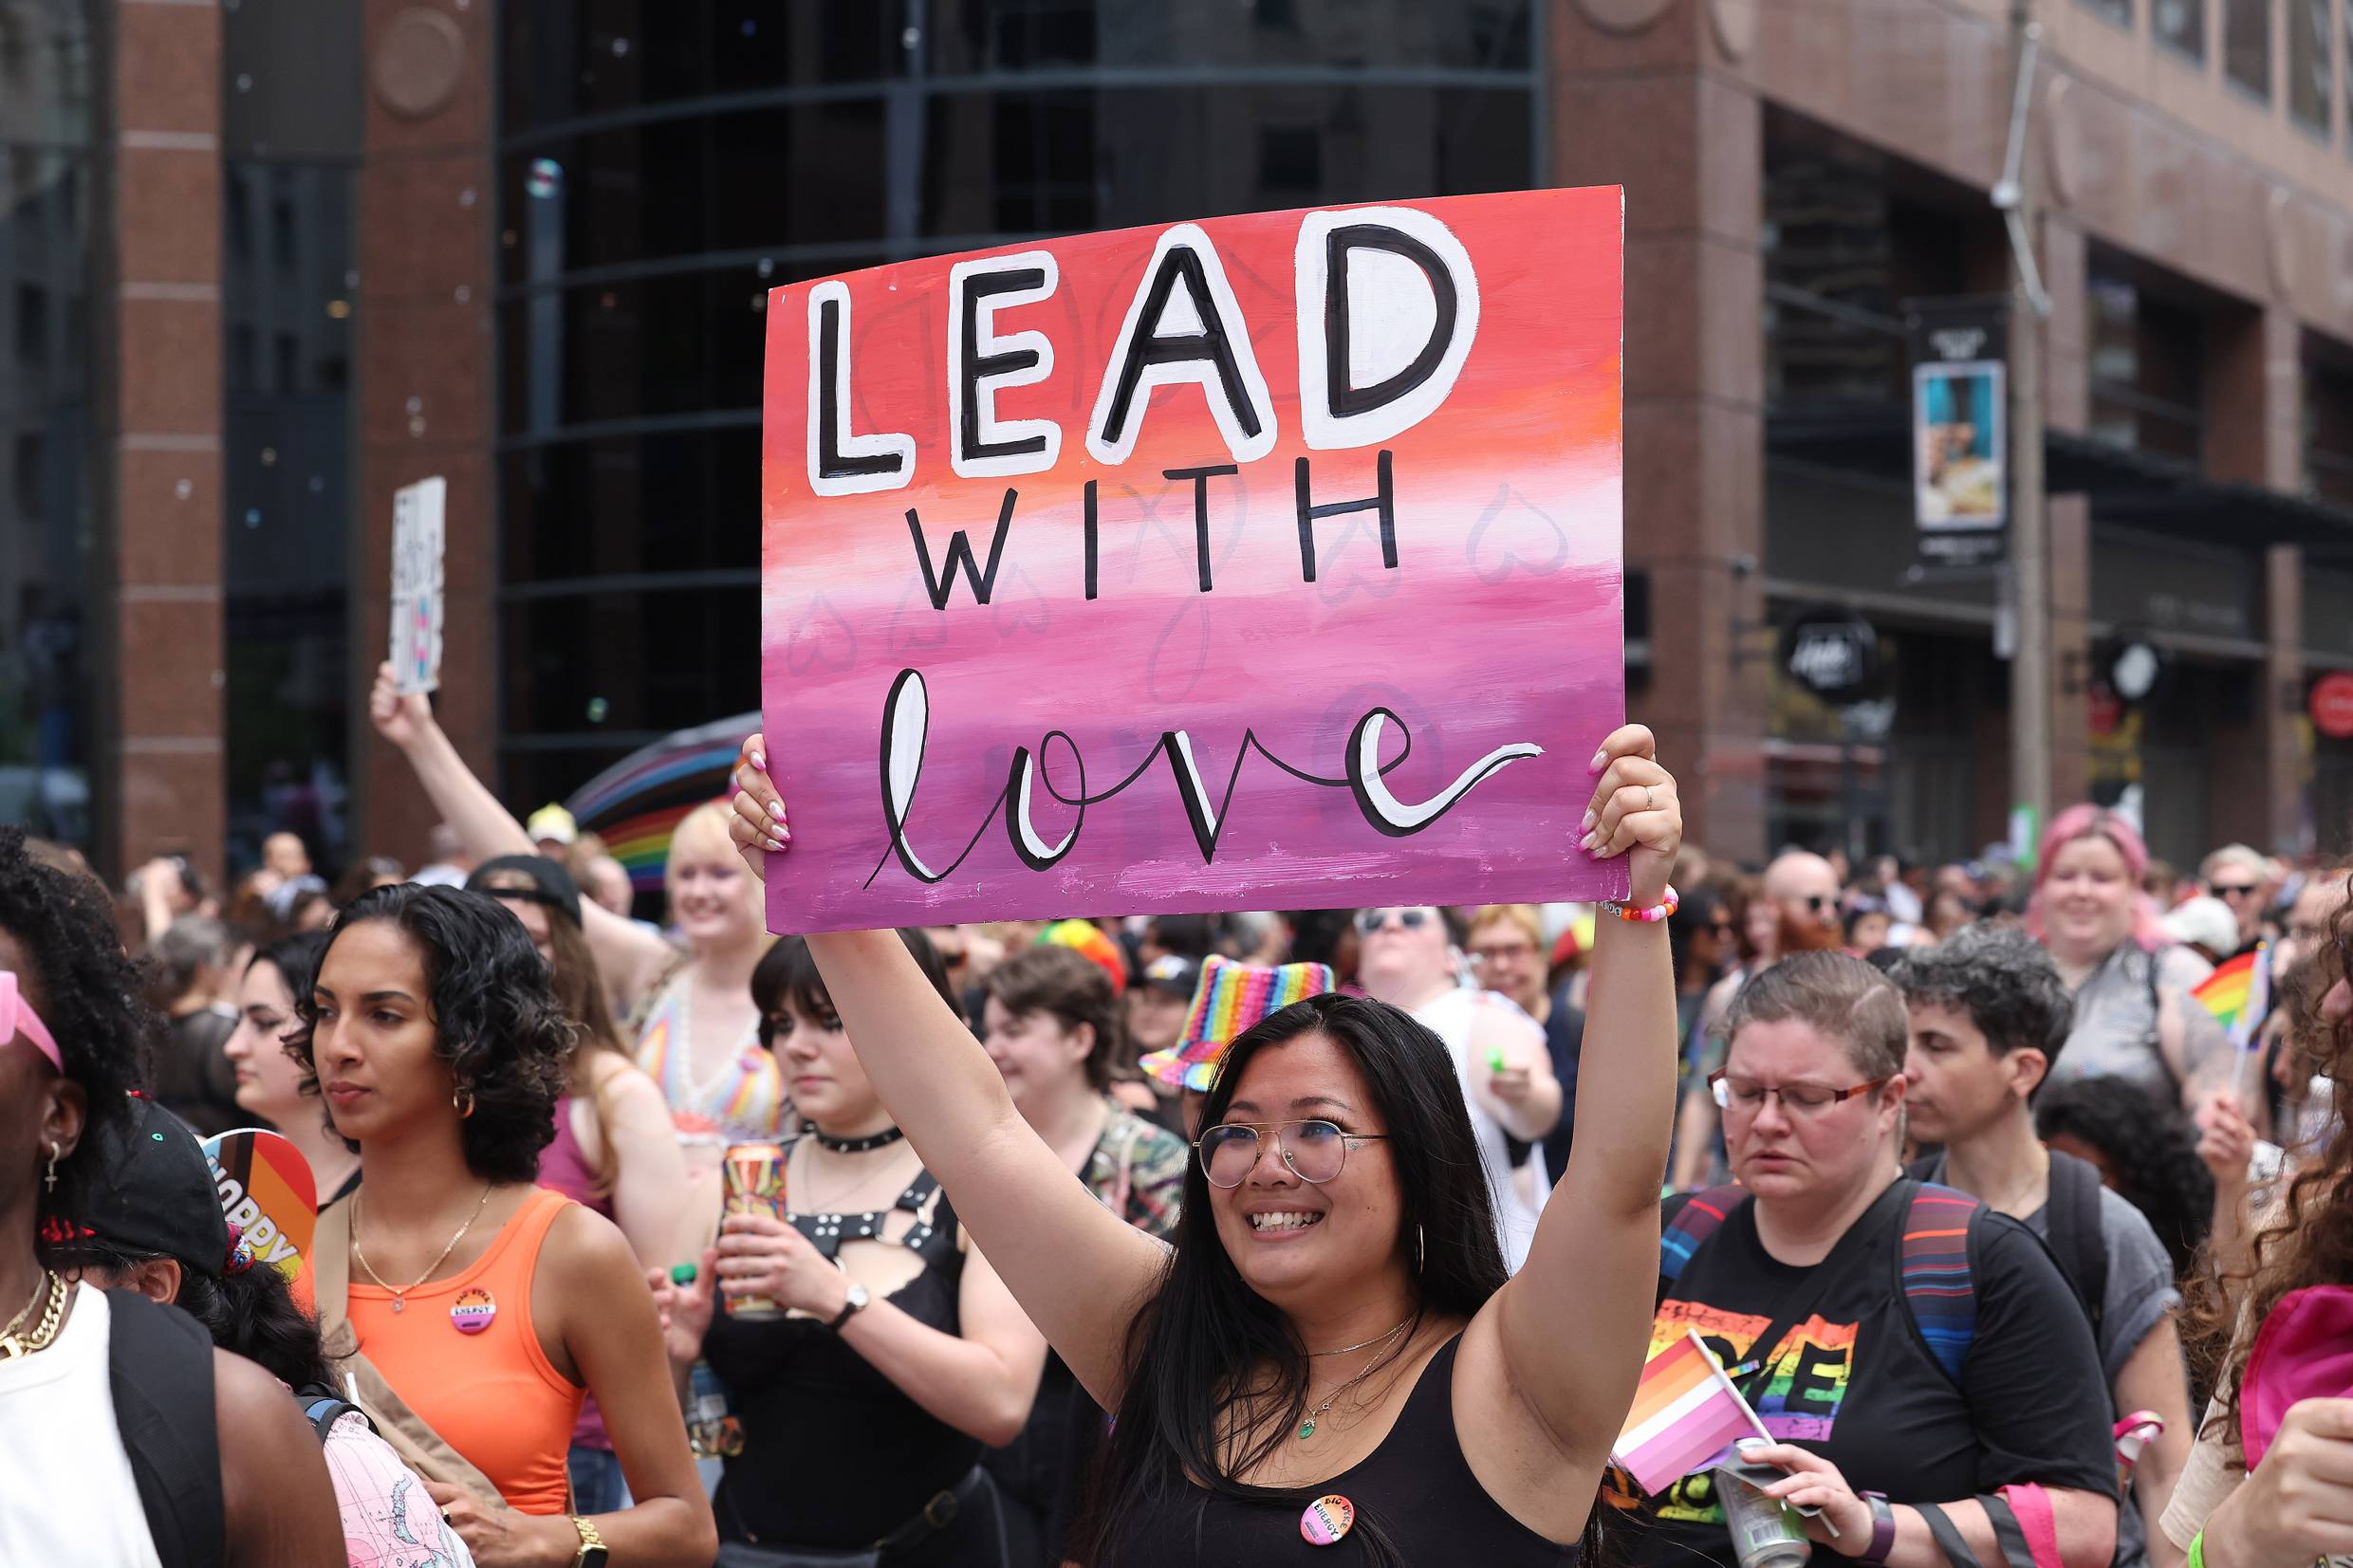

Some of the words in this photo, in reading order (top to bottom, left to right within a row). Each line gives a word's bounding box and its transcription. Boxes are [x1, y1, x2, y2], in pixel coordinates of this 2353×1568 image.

[806, 205, 1481, 497] LEAD
[904, 450, 1399, 610] WITH
[862, 668, 1545, 890] love
[1314, 1503, 1339, 1536] ENERGY
